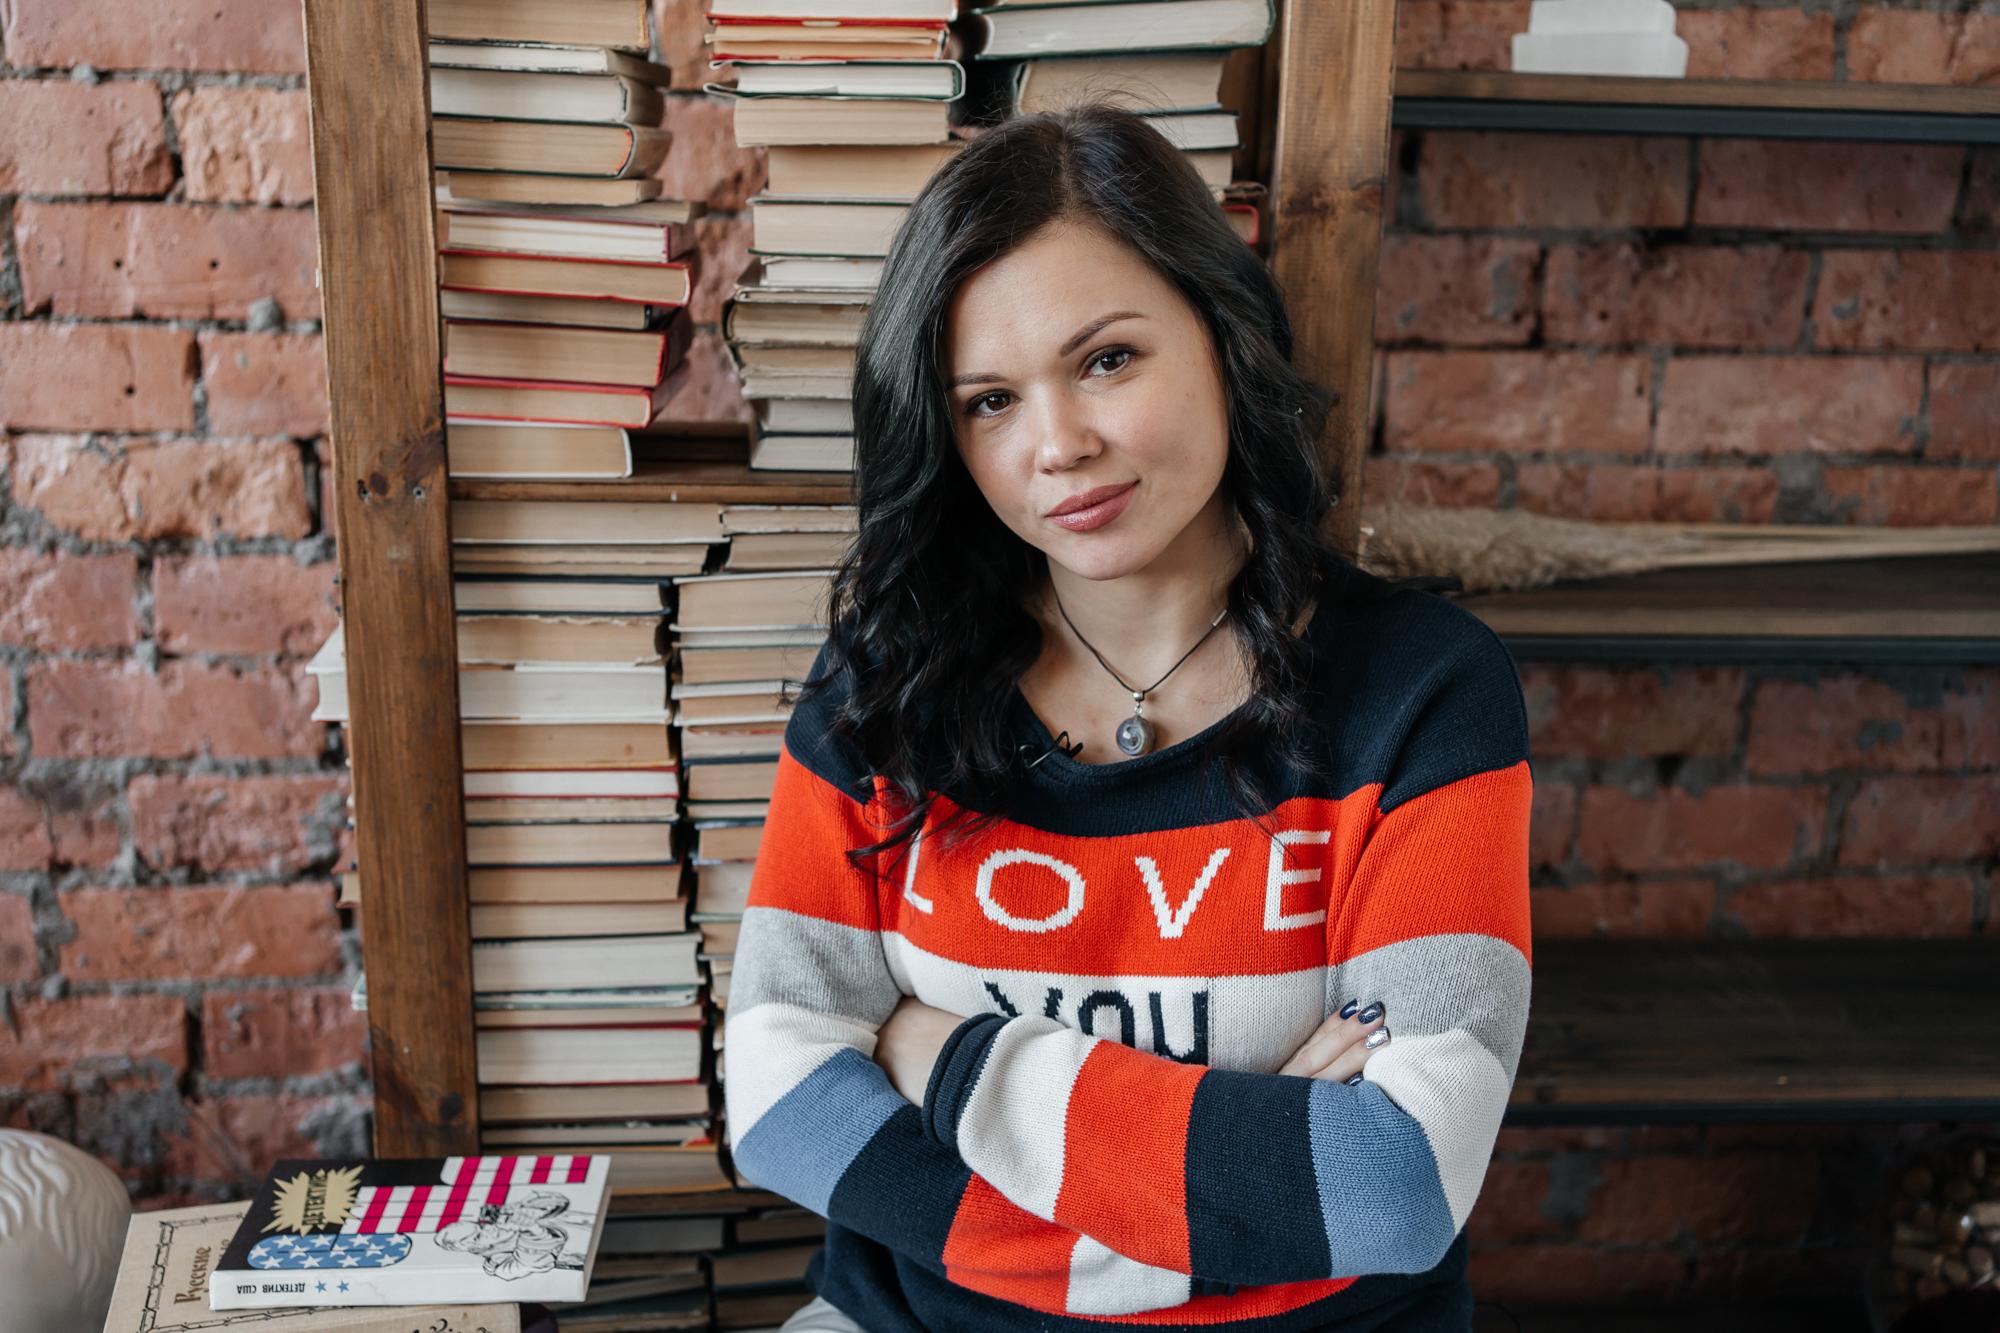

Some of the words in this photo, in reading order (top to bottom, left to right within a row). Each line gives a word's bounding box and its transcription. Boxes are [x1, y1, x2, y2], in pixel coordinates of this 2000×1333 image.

[904, 828, 1331, 939] LOVE
[173, 1246, 212, 1304] Русские
[236, 1284, 257, 1295] США
[262, 1282, 305, 1294] ДЕТЕКТИВ
